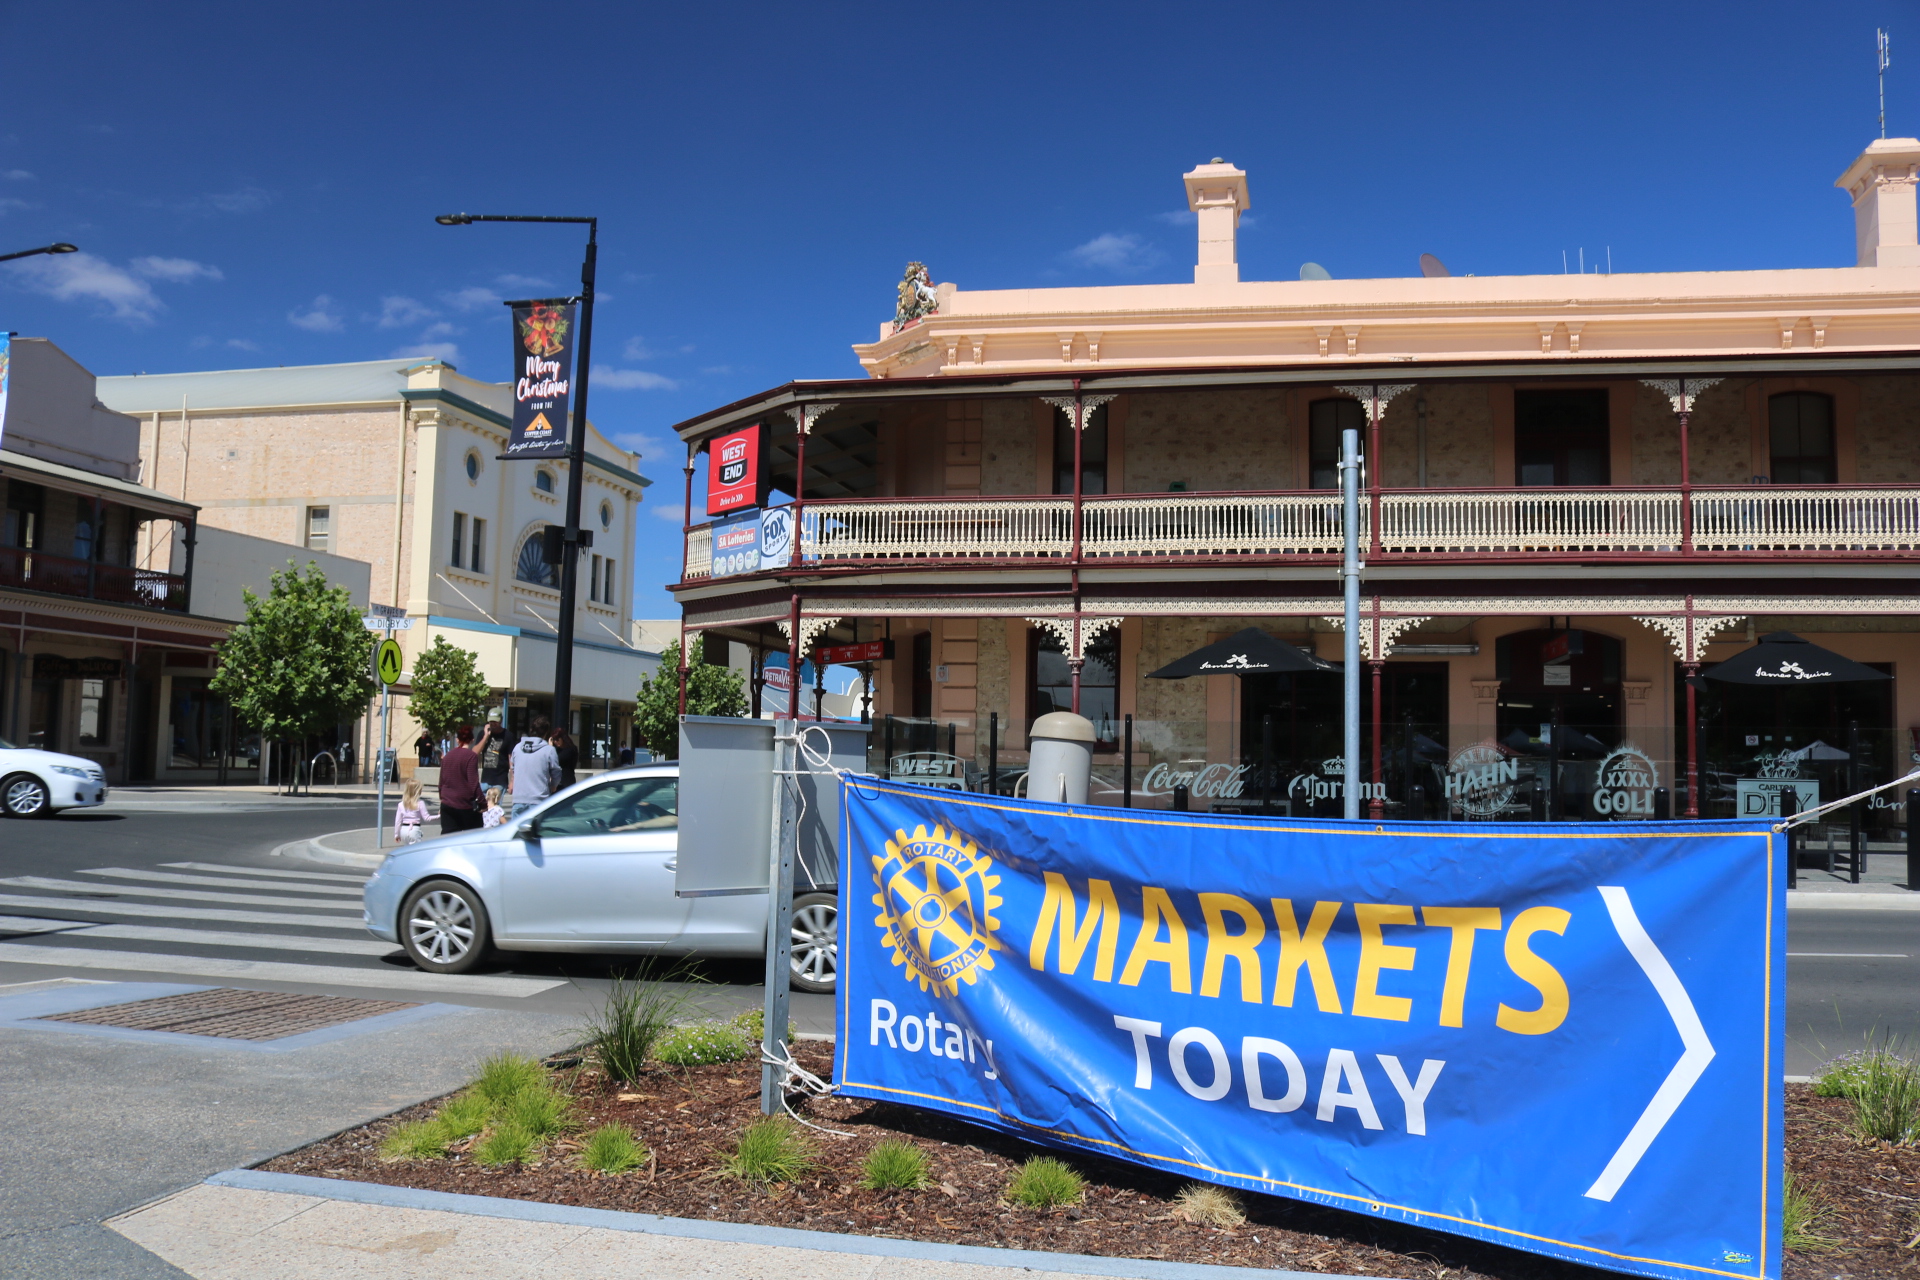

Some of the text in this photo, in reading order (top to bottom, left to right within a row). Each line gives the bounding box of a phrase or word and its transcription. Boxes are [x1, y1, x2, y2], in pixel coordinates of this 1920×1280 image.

[525, 355, 561, 381] Merry
[516, 377, 569, 402] Christmas
[722, 443, 747, 462] WEST
[723, 463, 743, 481] END
[718, 531, 754, 548] SA Lotteries
[763, 513, 787, 546] FOX
[764, 533, 787, 553] SPORTS
[377, 619, 400, 629] DIGBY
[1199, 661, 1270, 670] James Squire
[1755, 666, 1832, 680] James Squire
[898, 758, 957, 775] WEST
[1444, 757, 1518, 799] HAHN
[1142, 762, 1252, 798] Coca-Cola
[1287, 773, 1392, 808] Corna
[1605, 771, 1651, 788] XXXX
[905, 842, 968, 868] ROTARY
[893, 931, 983, 980] INTERNATIONAL
[1029, 871, 1572, 1035] MARKETS
[869, 998, 1000, 1081] Rotary
[1113, 1014, 1446, 1136] TODAY
